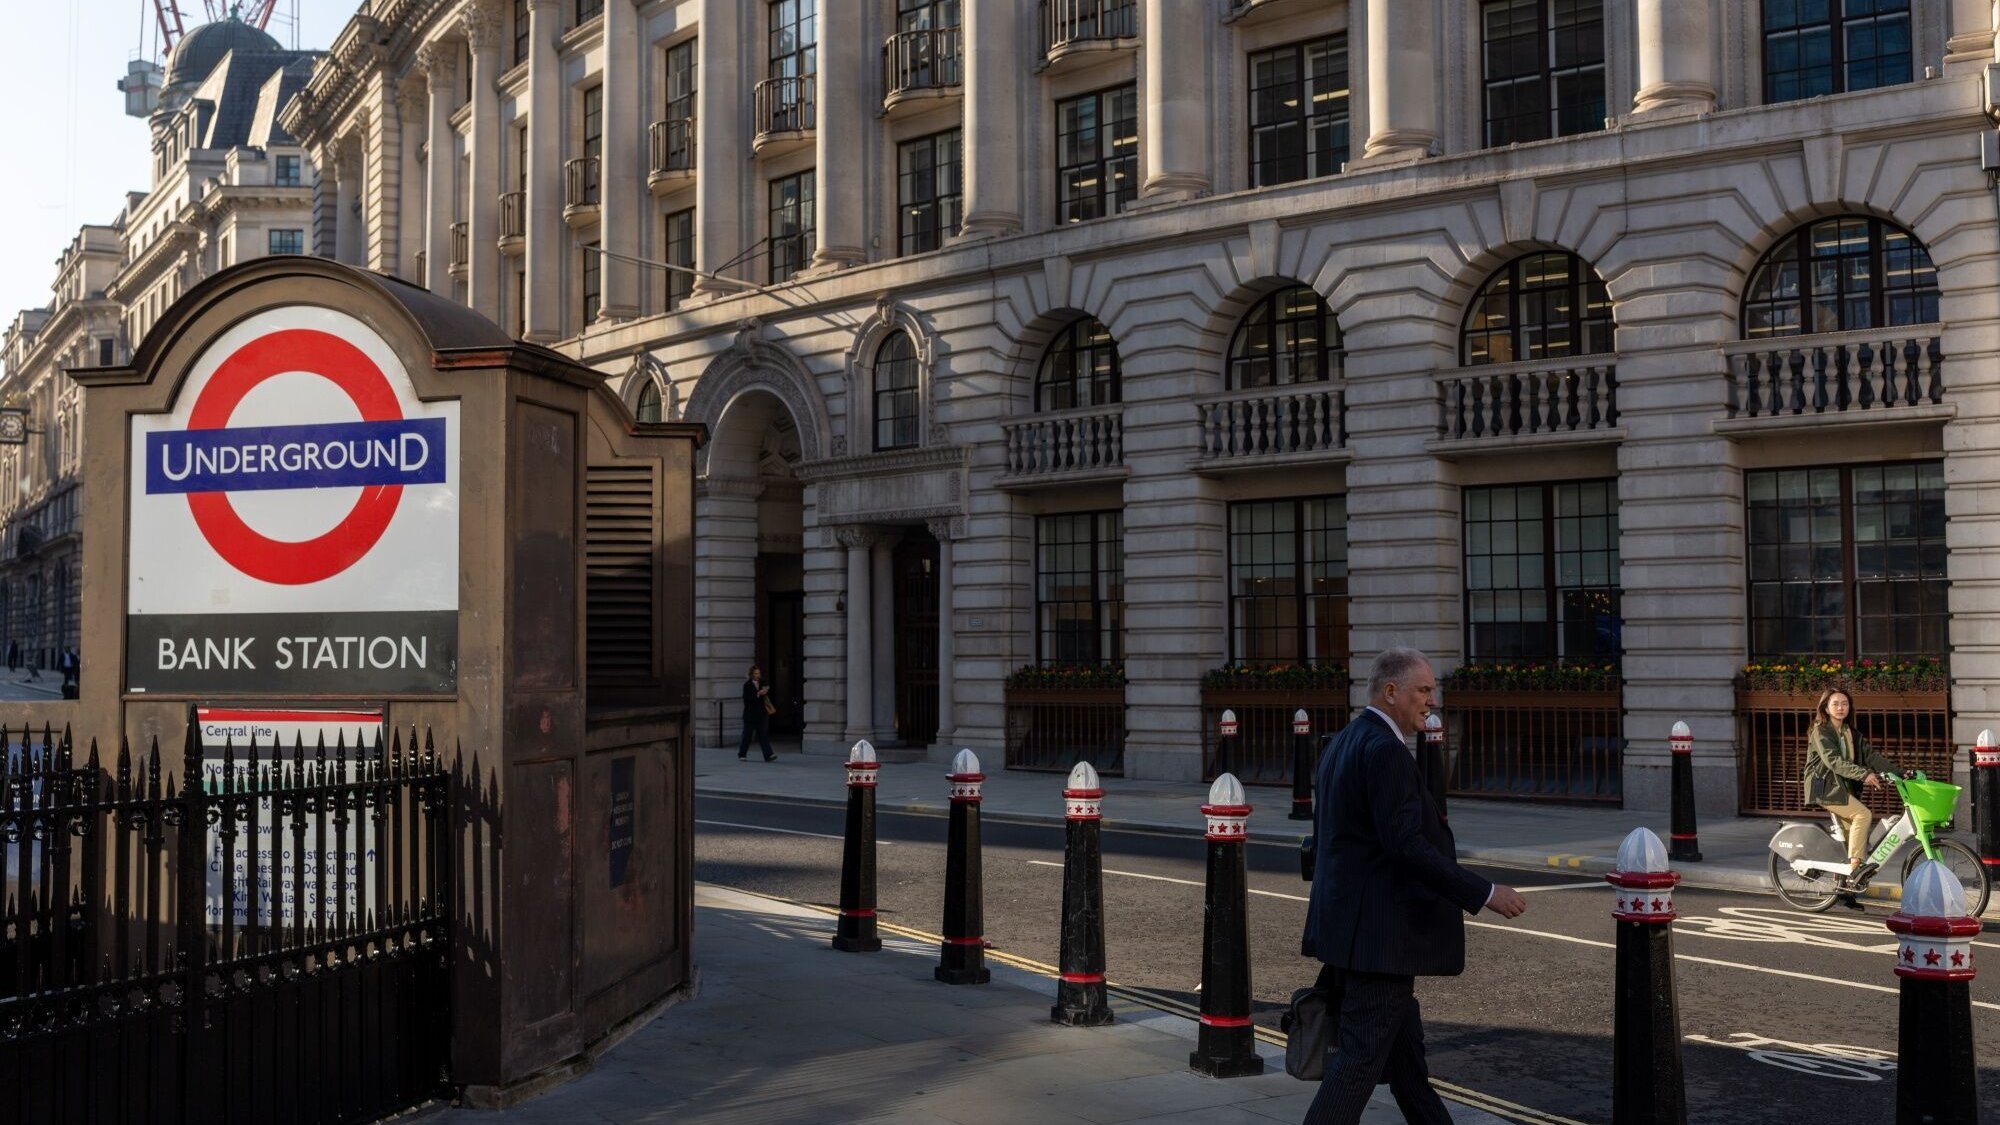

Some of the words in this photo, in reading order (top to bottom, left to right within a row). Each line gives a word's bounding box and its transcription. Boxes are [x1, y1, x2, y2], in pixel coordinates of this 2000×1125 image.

[162, 432, 429, 482] UNDERGROUND
[158, 637, 257, 670] BANK
[275, 636, 427, 670] STATION
[206, 725, 247, 737] Central
[236, 850, 273, 860] acess
[1871, 833, 1900, 863] Lime
